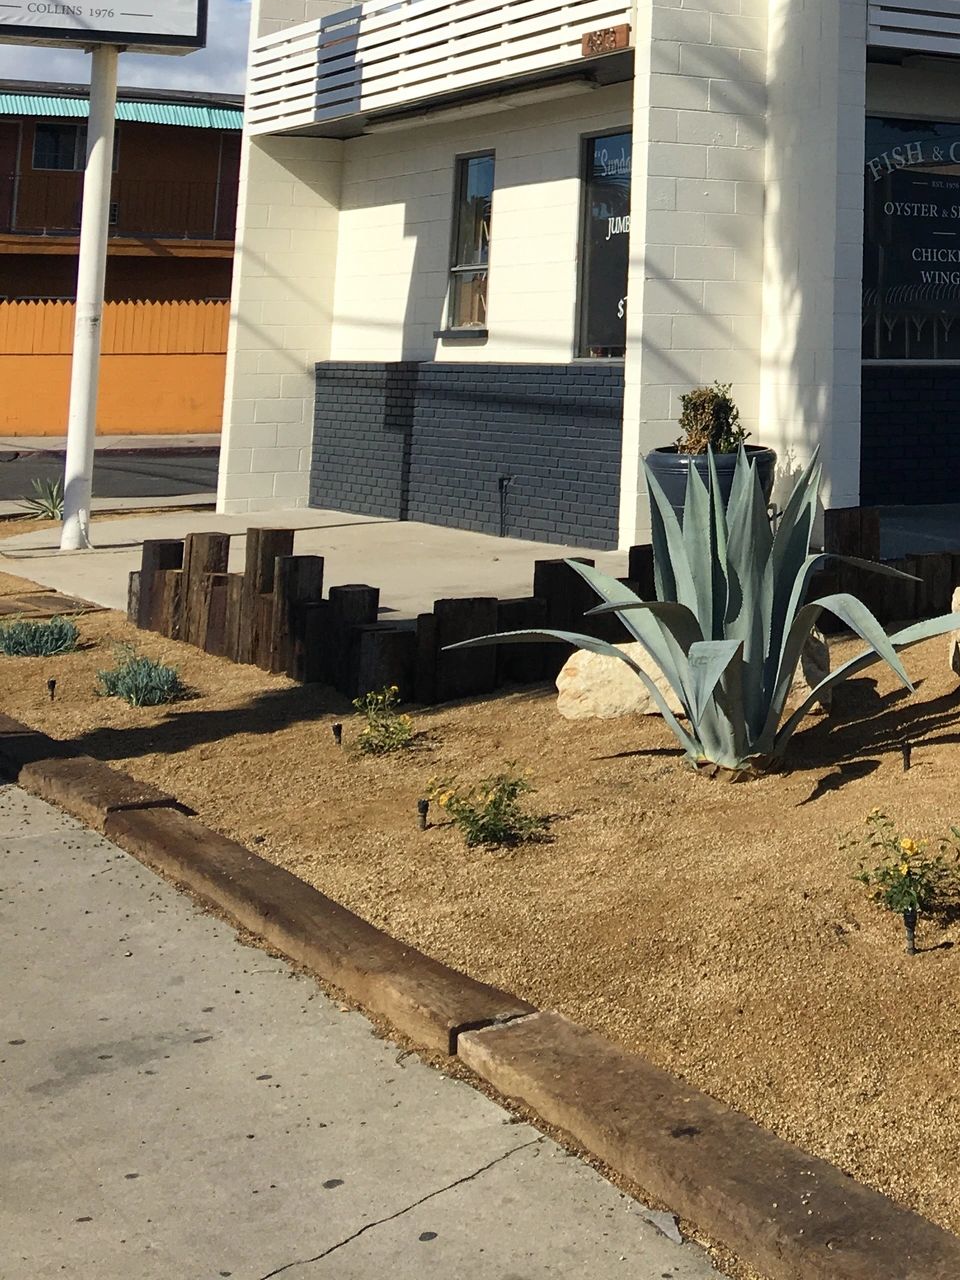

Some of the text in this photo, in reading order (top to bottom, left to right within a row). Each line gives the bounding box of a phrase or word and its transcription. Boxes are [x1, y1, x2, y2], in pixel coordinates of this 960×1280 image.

[27, 2, 115, 19] COLLINS 1976
[867, 141, 925, 182] FISH
[931, 145, 944, 161] &
[884, 201, 938, 218] OYSTER
[941, 208, 949, 218] &
